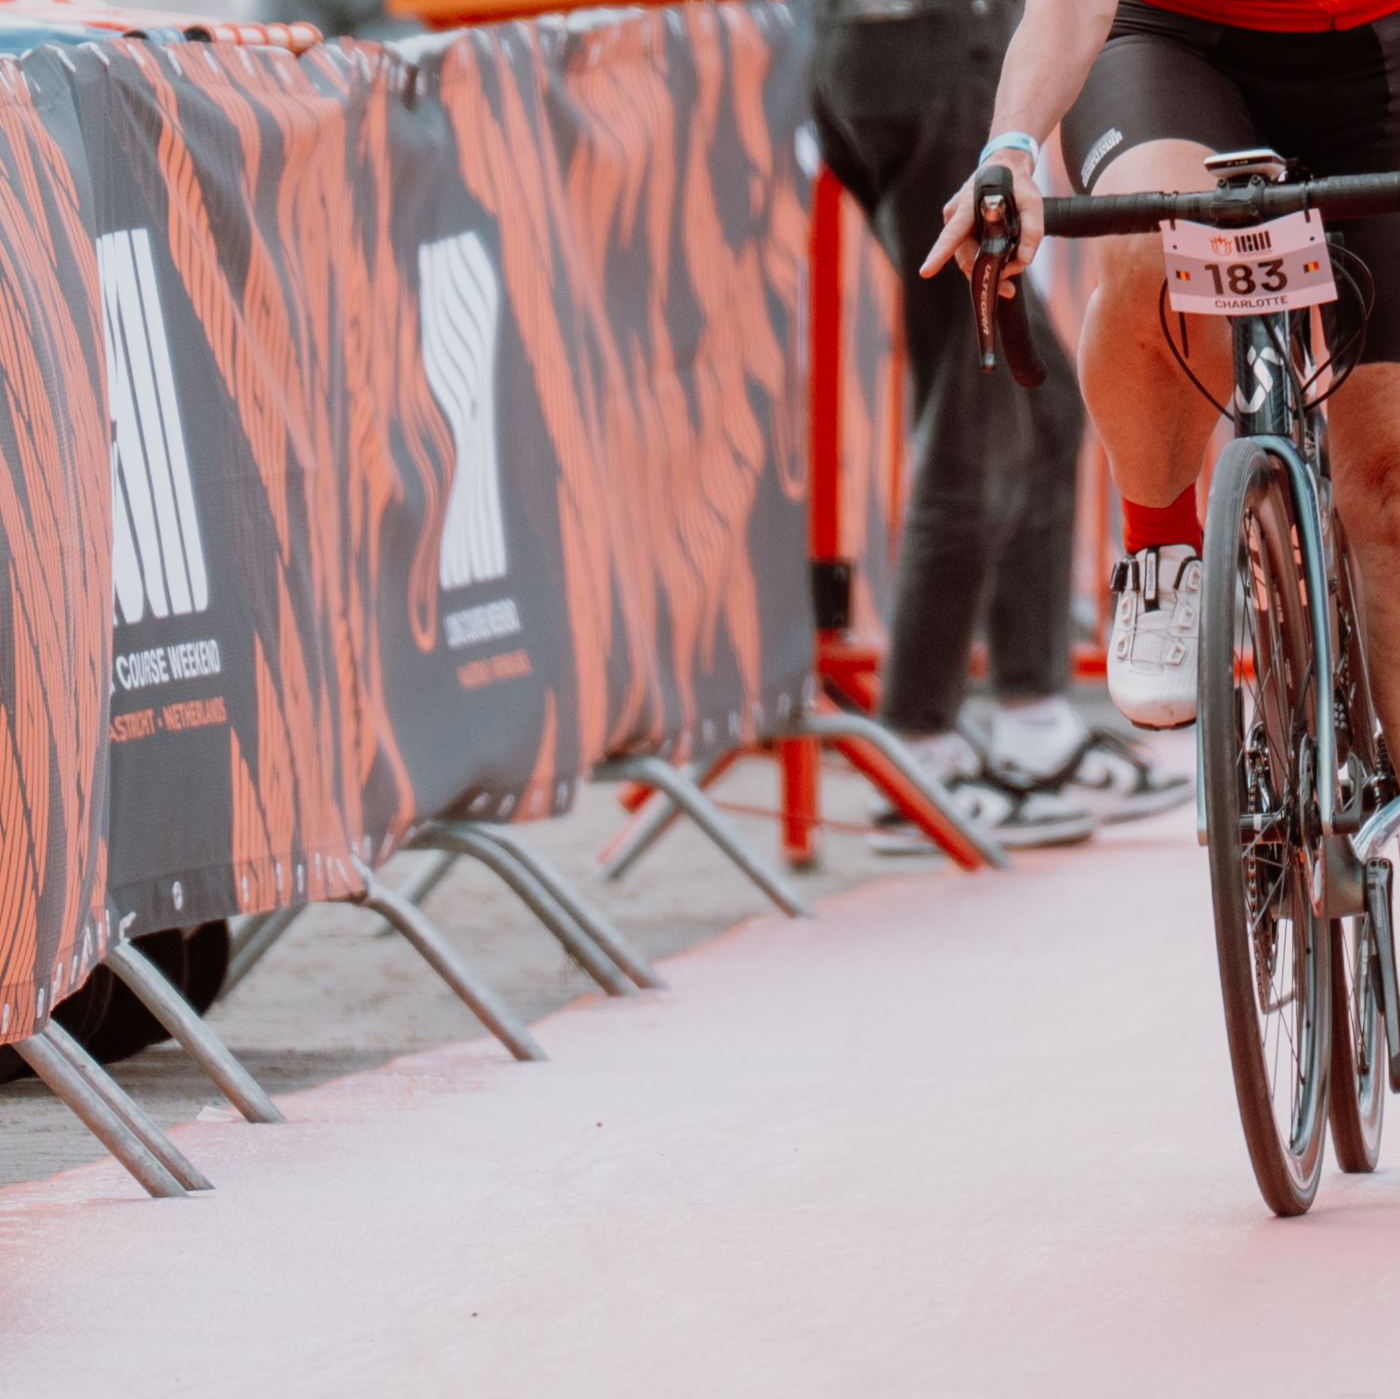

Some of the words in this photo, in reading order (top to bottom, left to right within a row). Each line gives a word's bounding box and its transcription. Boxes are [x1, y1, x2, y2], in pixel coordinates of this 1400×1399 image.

[1204, 258, 1288, 296] 183
[1215, 295, 1288, 309] CHARLOTTE
[115, 648, 170, 691] COURSE
[166, 639, 221, 681] WEEKEND
